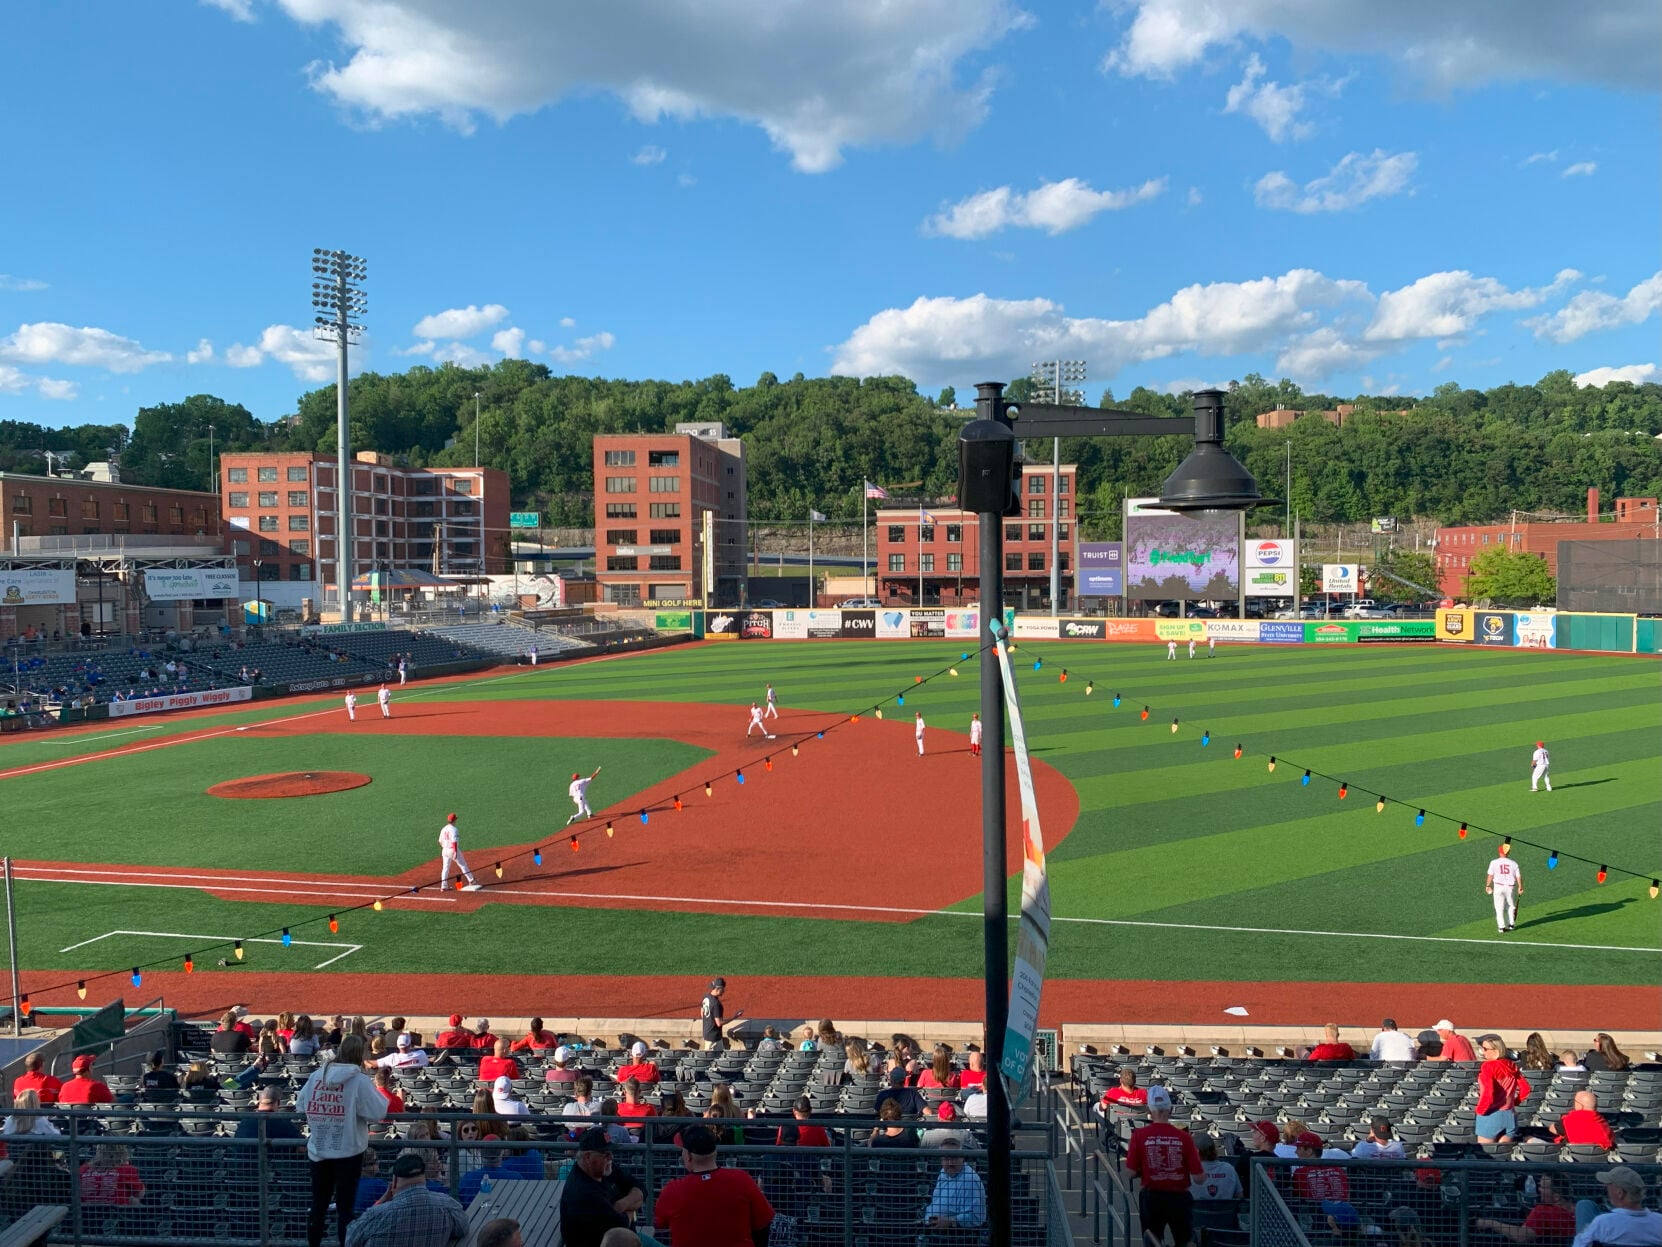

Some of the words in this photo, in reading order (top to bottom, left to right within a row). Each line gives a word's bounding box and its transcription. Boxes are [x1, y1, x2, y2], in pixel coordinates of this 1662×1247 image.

[324, 624, 352, 633] FAMILY
[354, 622, 385, 632] SECTION
[744, 620, 769, 629] PITCH
[845, 619, 874, 629] #CWV
[1076, 625, 1099, 633] CRW
[1261, 624, 1302, 632] GLENVILLE
[1372, 626, 1400, 634] Health
[1401, 625, 1435, 633] Network
[135, 701, 164, 710] Bigley
[170, 696, 197, 706] Piggly
[202, 692, 230, 702] Wiggly
[1500, 864, 1509, 874] 15
[1004, 1057, 1015, 1070] OF
[312, 1091, 343, 1102] Lane
[307, 1102, 344, 1113] Bryan
